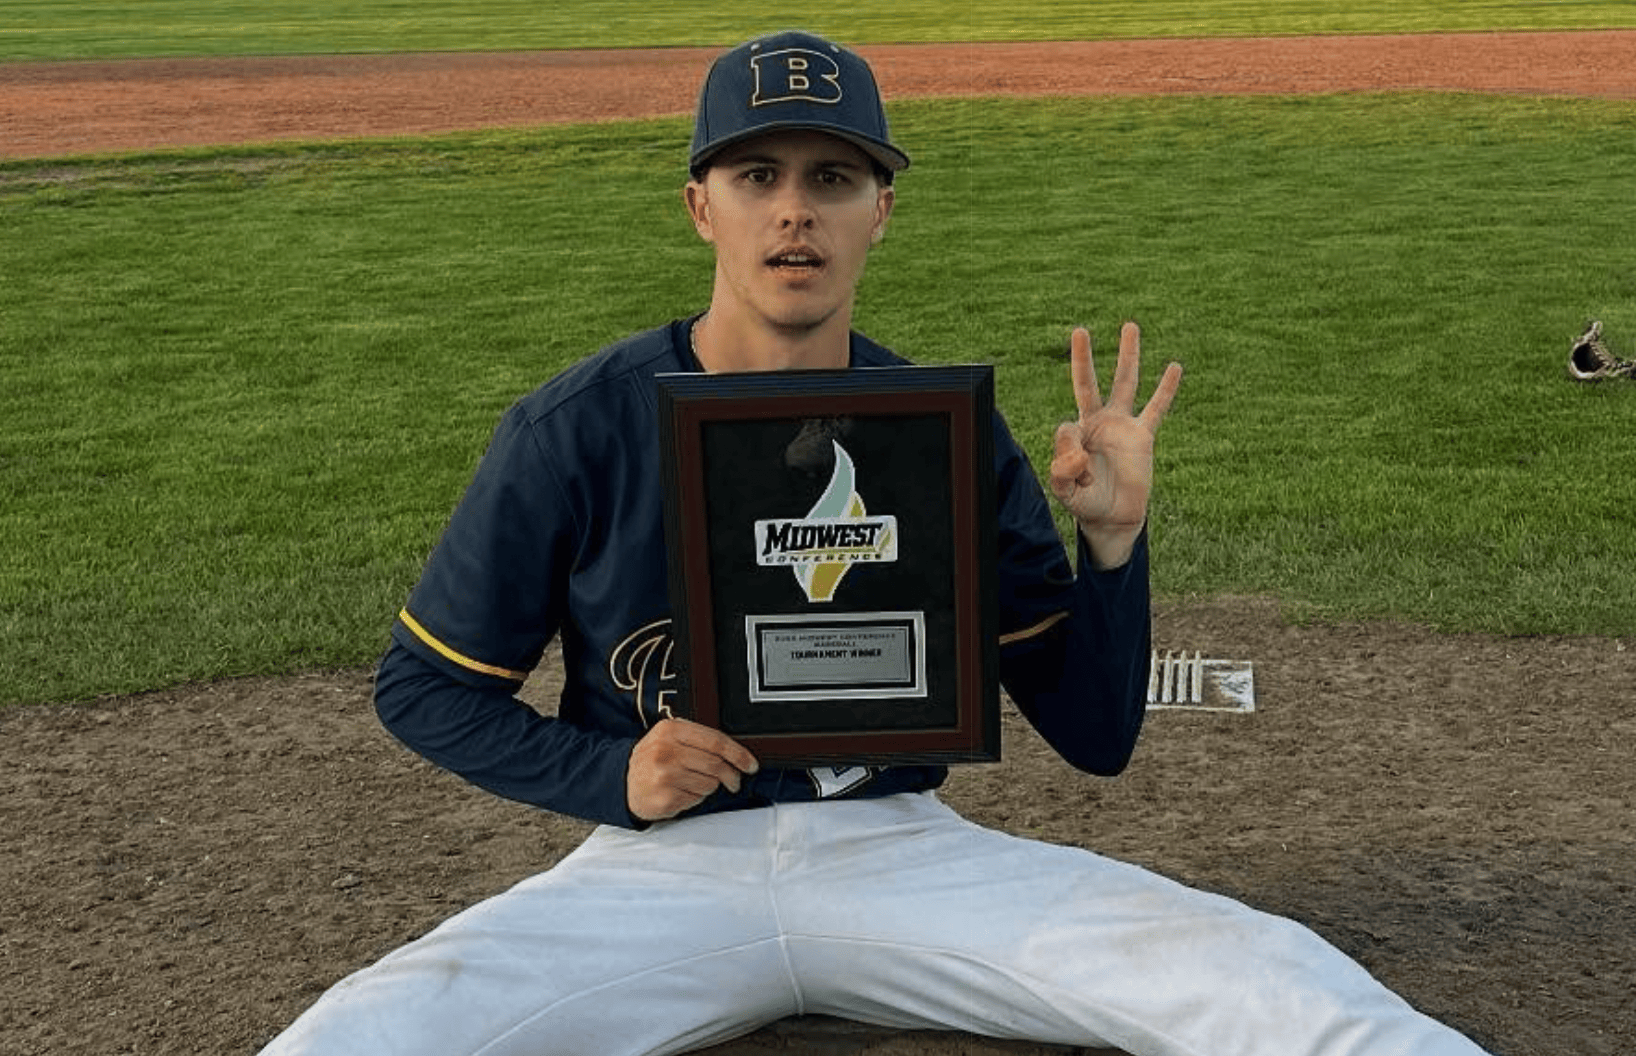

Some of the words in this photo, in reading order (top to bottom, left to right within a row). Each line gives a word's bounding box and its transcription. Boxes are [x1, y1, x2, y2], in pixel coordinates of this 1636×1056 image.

[750, 47, 842, 107] B
[762, 522, 884, 556] MIDWEST
[765, 553, 881, 563] CONFERENCE
[791, 650, 848, 659] TOURNAMENT
